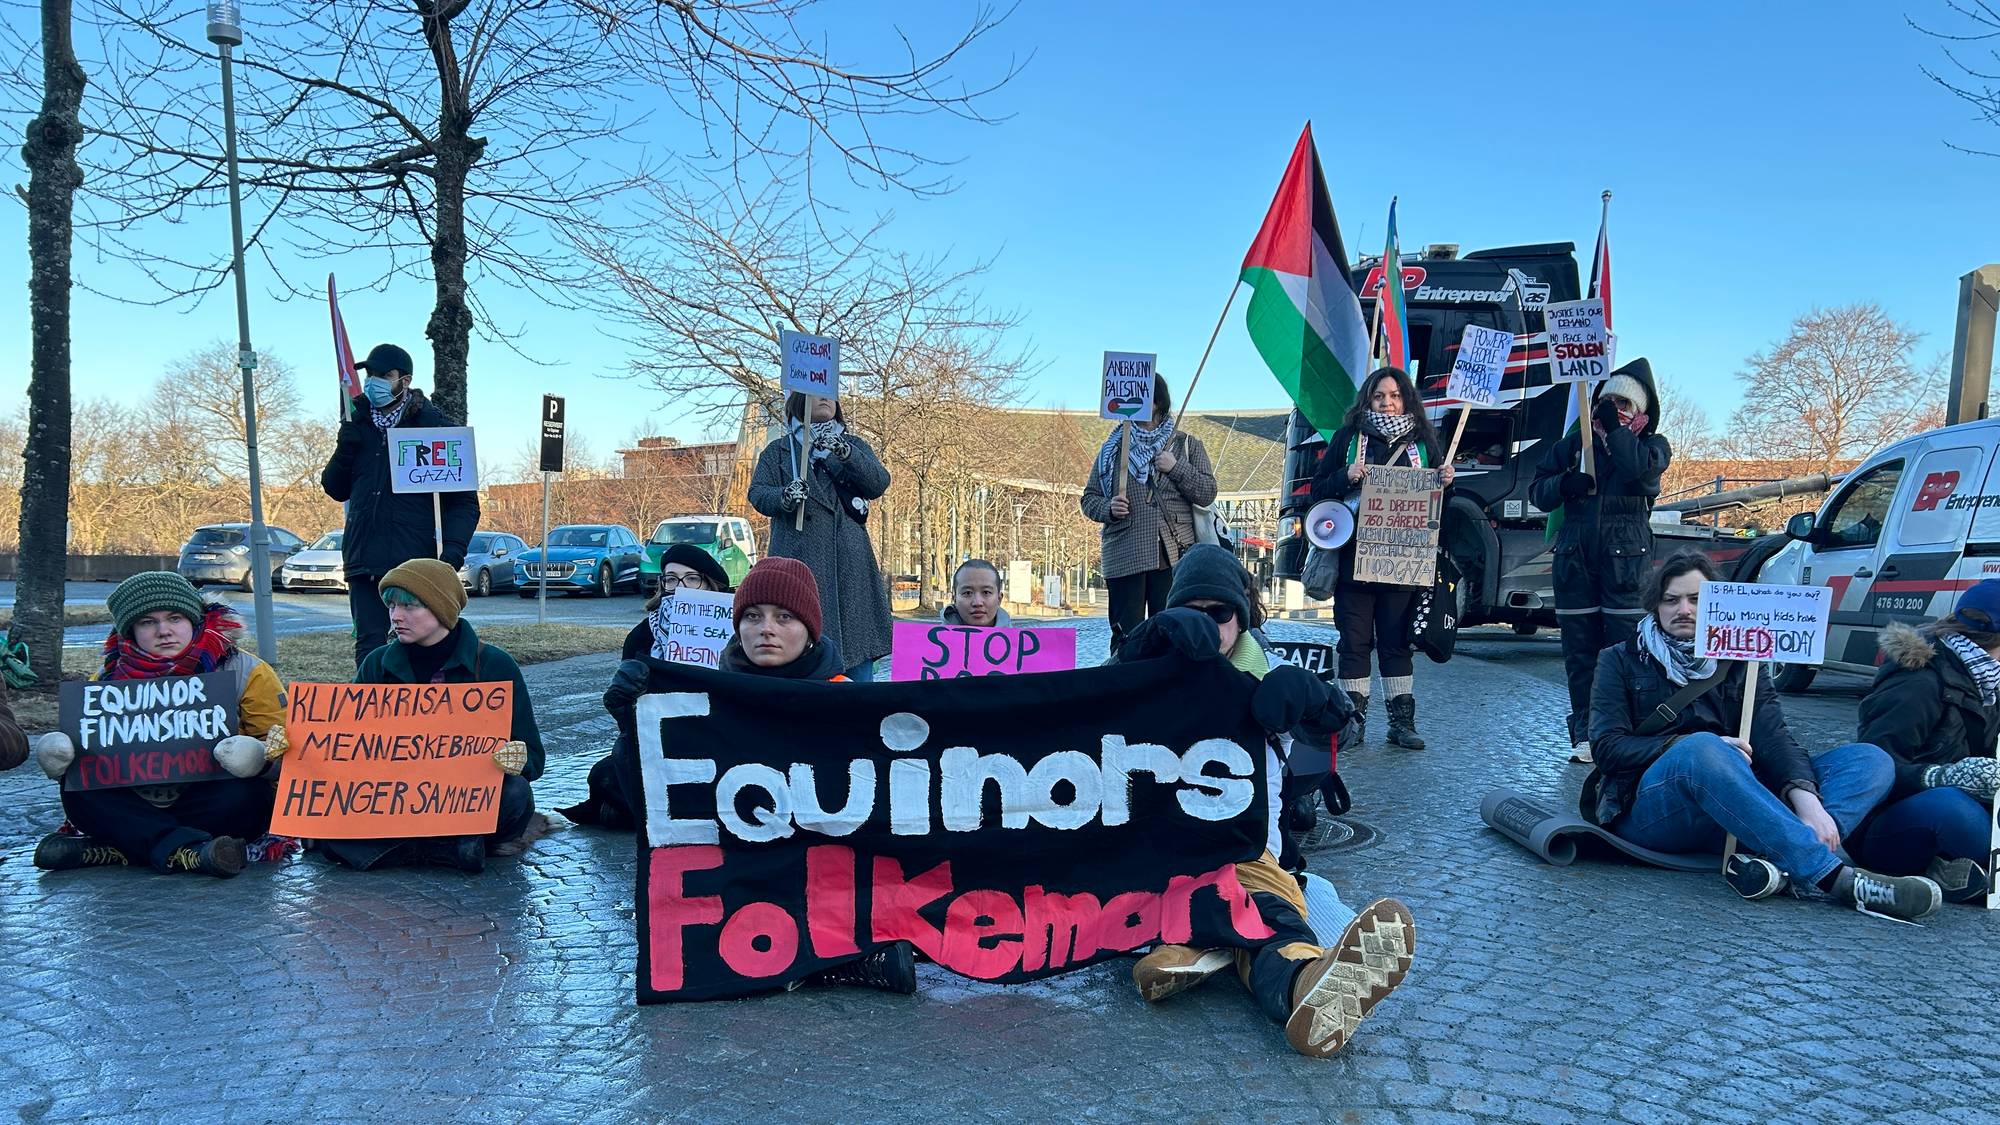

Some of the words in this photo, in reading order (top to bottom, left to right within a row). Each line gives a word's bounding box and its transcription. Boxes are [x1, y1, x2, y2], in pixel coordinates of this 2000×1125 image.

[1524, 293, 1546, 303] as
[1547, 308, 1574, 319] JUSTICE
[1576, 308, 1585, 316] IS
[1587, 307, 1603, 317] OUR
[1558, 318, 1591, 328] DEMAND
[793, 339, 809, 354] GAZA
[1473, 328, 1508, 349] POWER
[1550, 333, 1559, 343] NO
[1562, 333, 1583, 343] PEACE
[1586, 332, 1597, 341] ON
[1469, 346, 1500, 364] PEOPLE
[1554, 342, 1604, 359] STOLEN
[1558, 360, 1603, 376] LAND
[1105, 379, 1149, 398] PALESTINA
[1459, 384, 1491, 404] POWER
[550, 400, 558, 419] P
[398, 440, 462, 467] FREE
[409, 467, 462, 484] GAZA!
[1912, 471, 1960, 512] BP
[1368, 498, 1384, 512] 112
[1390, 500, 1429, 513] DREPTE
[1364, 514, 1383, 526] 760
[674, 601, 696, 616] FROM
[698, 604, 714, 617] THE
[713, 605, 733, 620] RIVE
[1707, 602, 1736, 621] How
[1876, 597, 1891, 609] 476
[1893, 598, 1904, 609] 30
[1906, 598, 1923, 610] 200
[670, 622, 682, 634] TO
[683, 624, 699, 636] THE
[703, 627, 729, 639] SEA
[921, 626, 1040, 672] STOP
[1707, 625, 1773, 653] KILLED
[1769, 629, 1816, 657] TODAY
[667, 641, 719, 666] PALESTIN
[84, 676, 207, 716] EQUINOR
[291, 685, 454, 725] KLIMAKRISA
[462, 687, 506, 712] OG
[80, 704, 231, 750] FINANSIERER
[80, 748, 217, 790] FOLKEMOR
[635, 692, 1255, 847] Equinors
[283, 778, 409, 817] HENGER
[410, 781, 496, 815] SAMMEN
